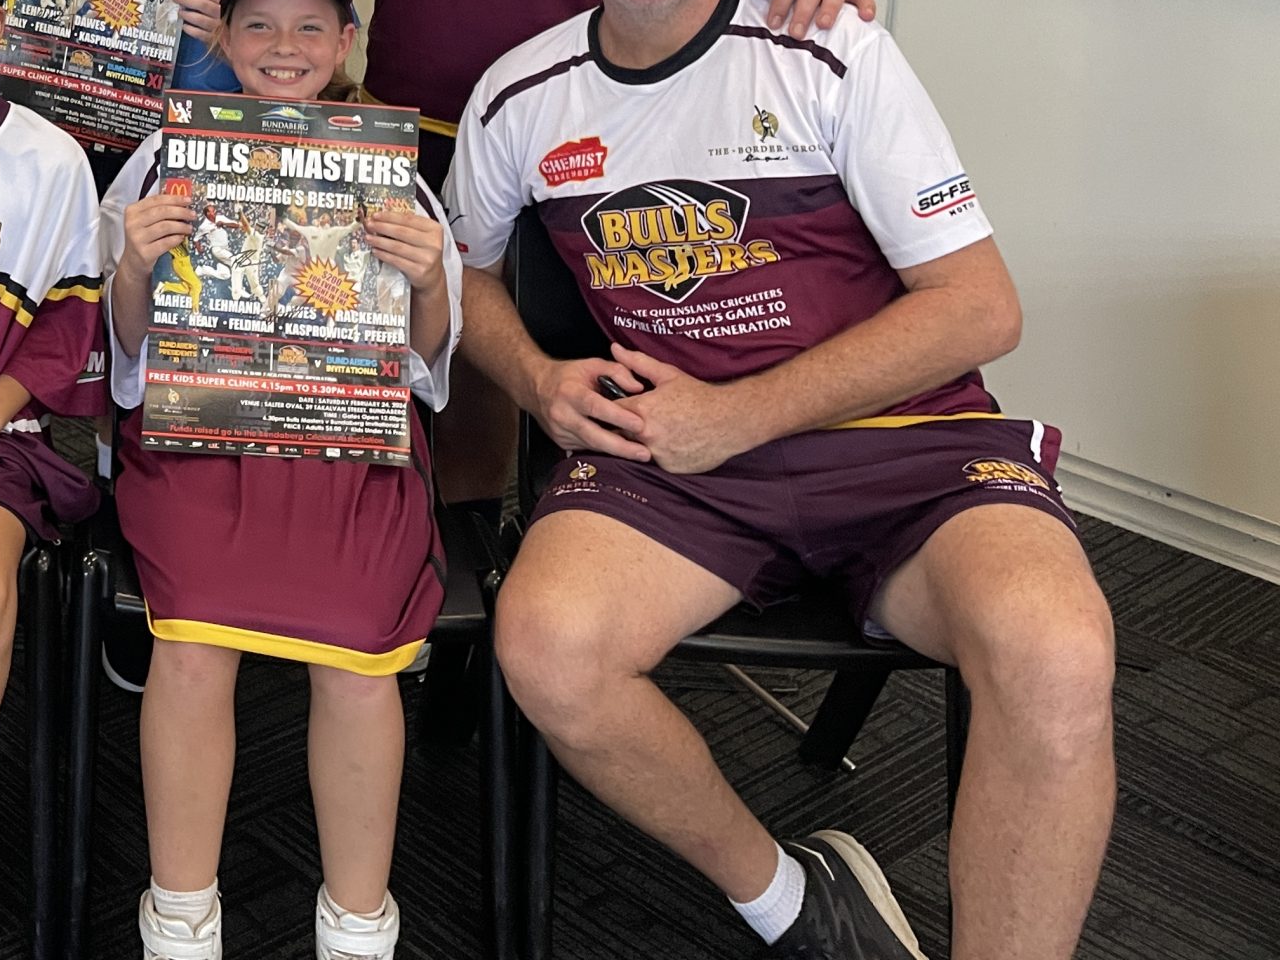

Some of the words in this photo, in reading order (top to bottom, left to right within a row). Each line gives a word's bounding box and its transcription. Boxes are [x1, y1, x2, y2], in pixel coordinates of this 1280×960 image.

[261, 120, 308, 131] BUNDABERG
[167, 137, 249, 174] BULLS
[279, 147, 411, 188] MASTERS
[541, 151, 604, 175] CHEMIST
[708, 147, 729, 156] THE
[738, 144, 784, 154] BORDER
[206, 182, 305, 207] BUNDABERG'S
[309, 190, 353, 211] BEST!!
[597, 199, 738, 250] BULLS
[584, 240, 781, 290] MASTERS
[155, 294, 191, 308] MAHER
[209, 298, 260, 314] LEHMANN
[336, 309, 405, 327] RACKEMANN
[649, 301, 718, 318] QUEENSLAND
[720, 288, 783, 308] CRICKETERS
[668, 313, 724, 328] TODAY'S
[725, 305, 765, 321] GAME
[766, 300, 787, 313] TO
[154, 312, 178, 325] DALE
[188, 315, 217, 328] HEALY
[228, 318, 274, 333] FELDMAN
[285, 323, 352, 340] KASPROWICZ
[364, 330, 404, 344] PFEFFER
[703, 315, 791, 338] GENERATION
